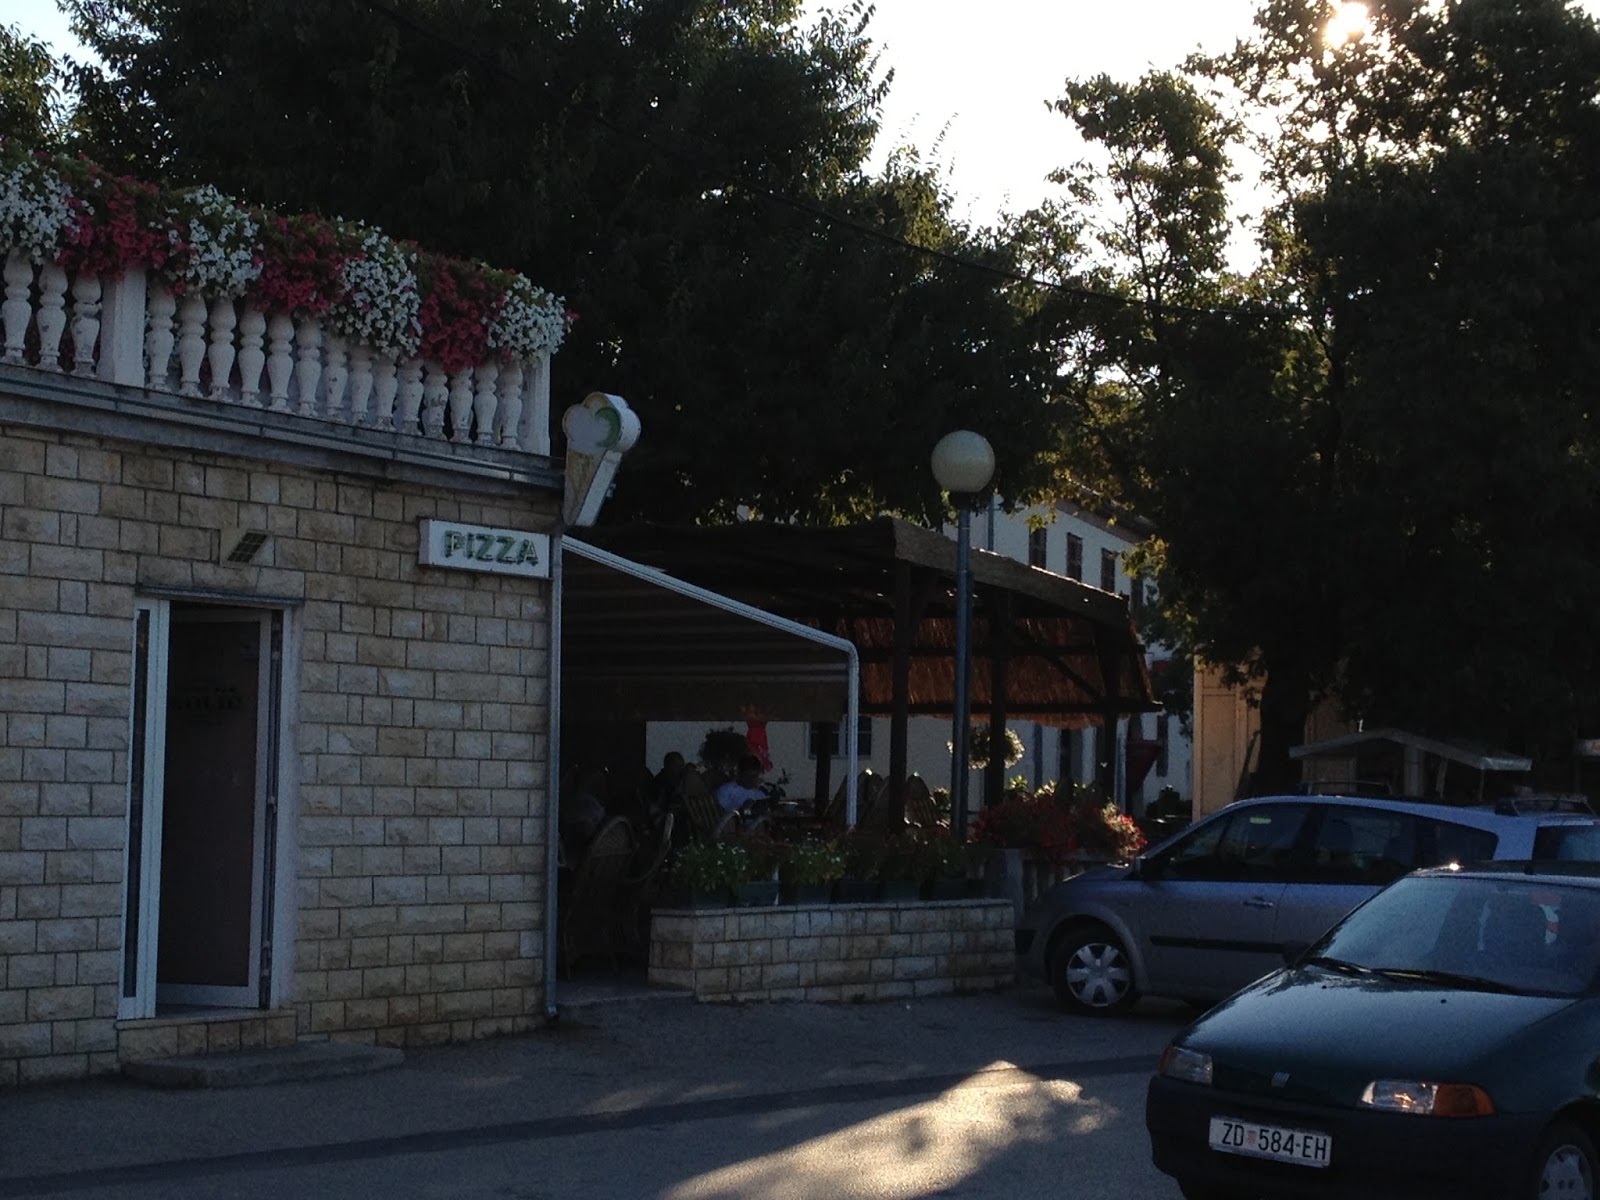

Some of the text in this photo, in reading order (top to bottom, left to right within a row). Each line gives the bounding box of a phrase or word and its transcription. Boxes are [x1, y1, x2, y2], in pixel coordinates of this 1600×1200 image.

[444, 530, 539, 567] PIZZA
[1222, 1122, 1327, 1160] ZD 584-EH
